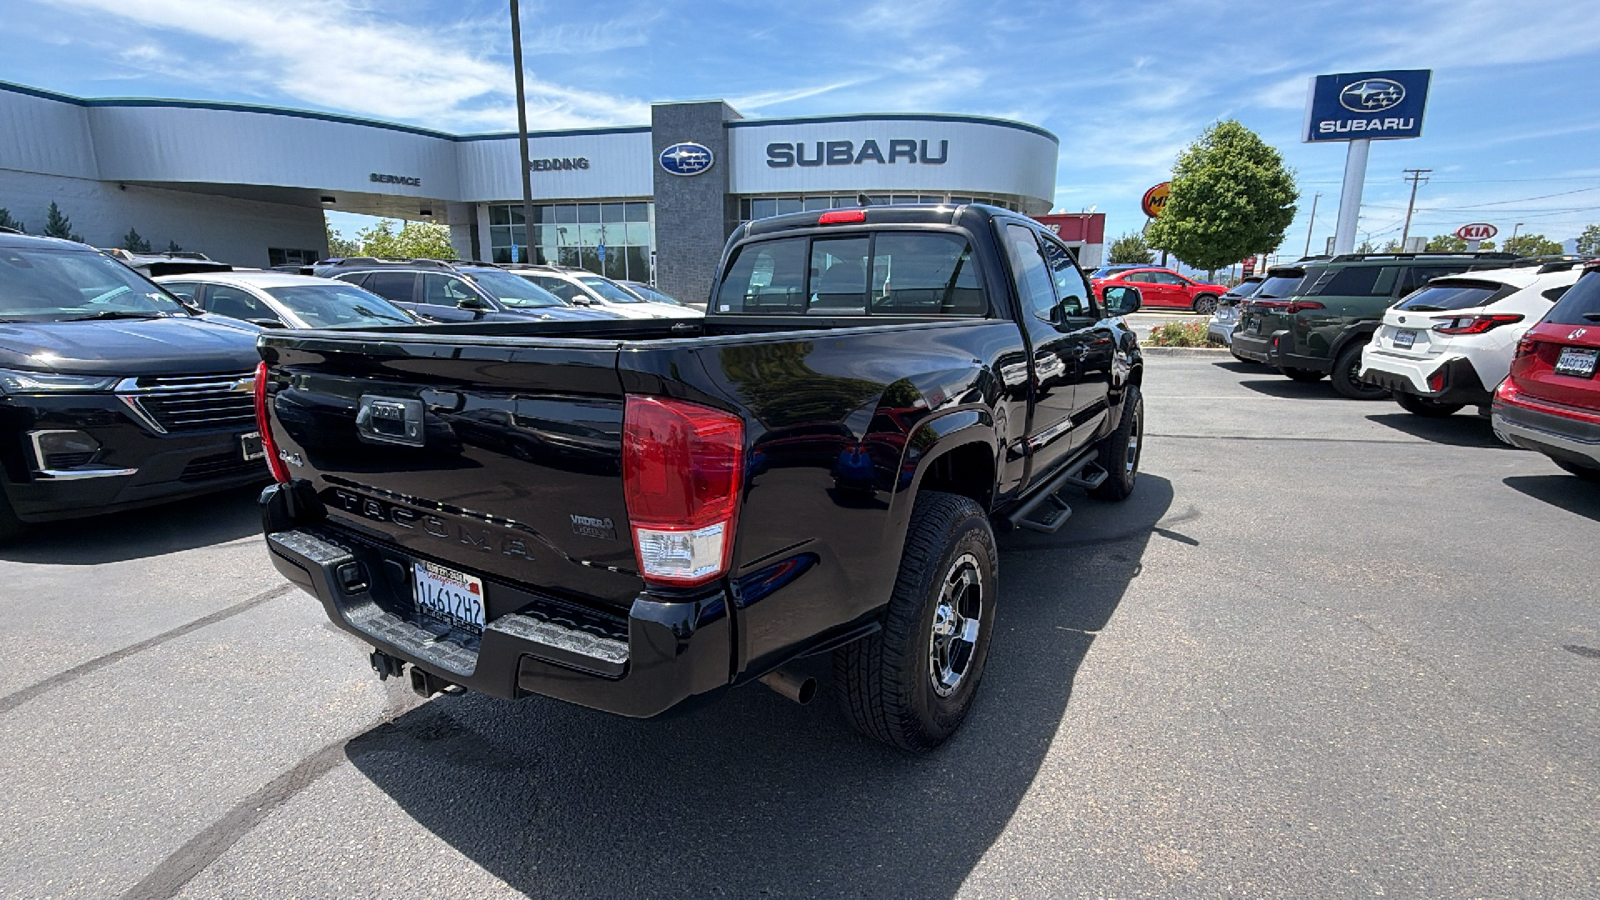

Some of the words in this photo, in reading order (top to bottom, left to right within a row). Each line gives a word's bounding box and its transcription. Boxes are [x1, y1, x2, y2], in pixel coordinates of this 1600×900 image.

[1319, 117, 1415, 133] SUBARU
[766, 139, 949, 168] SUBARU
[369, 172, 421, 187] SERVICE
[1464, 226, 1491, 238] KIA
[336, 489, 535, 561] TACOMA
[420, 581, 484, 627] 14612H2
